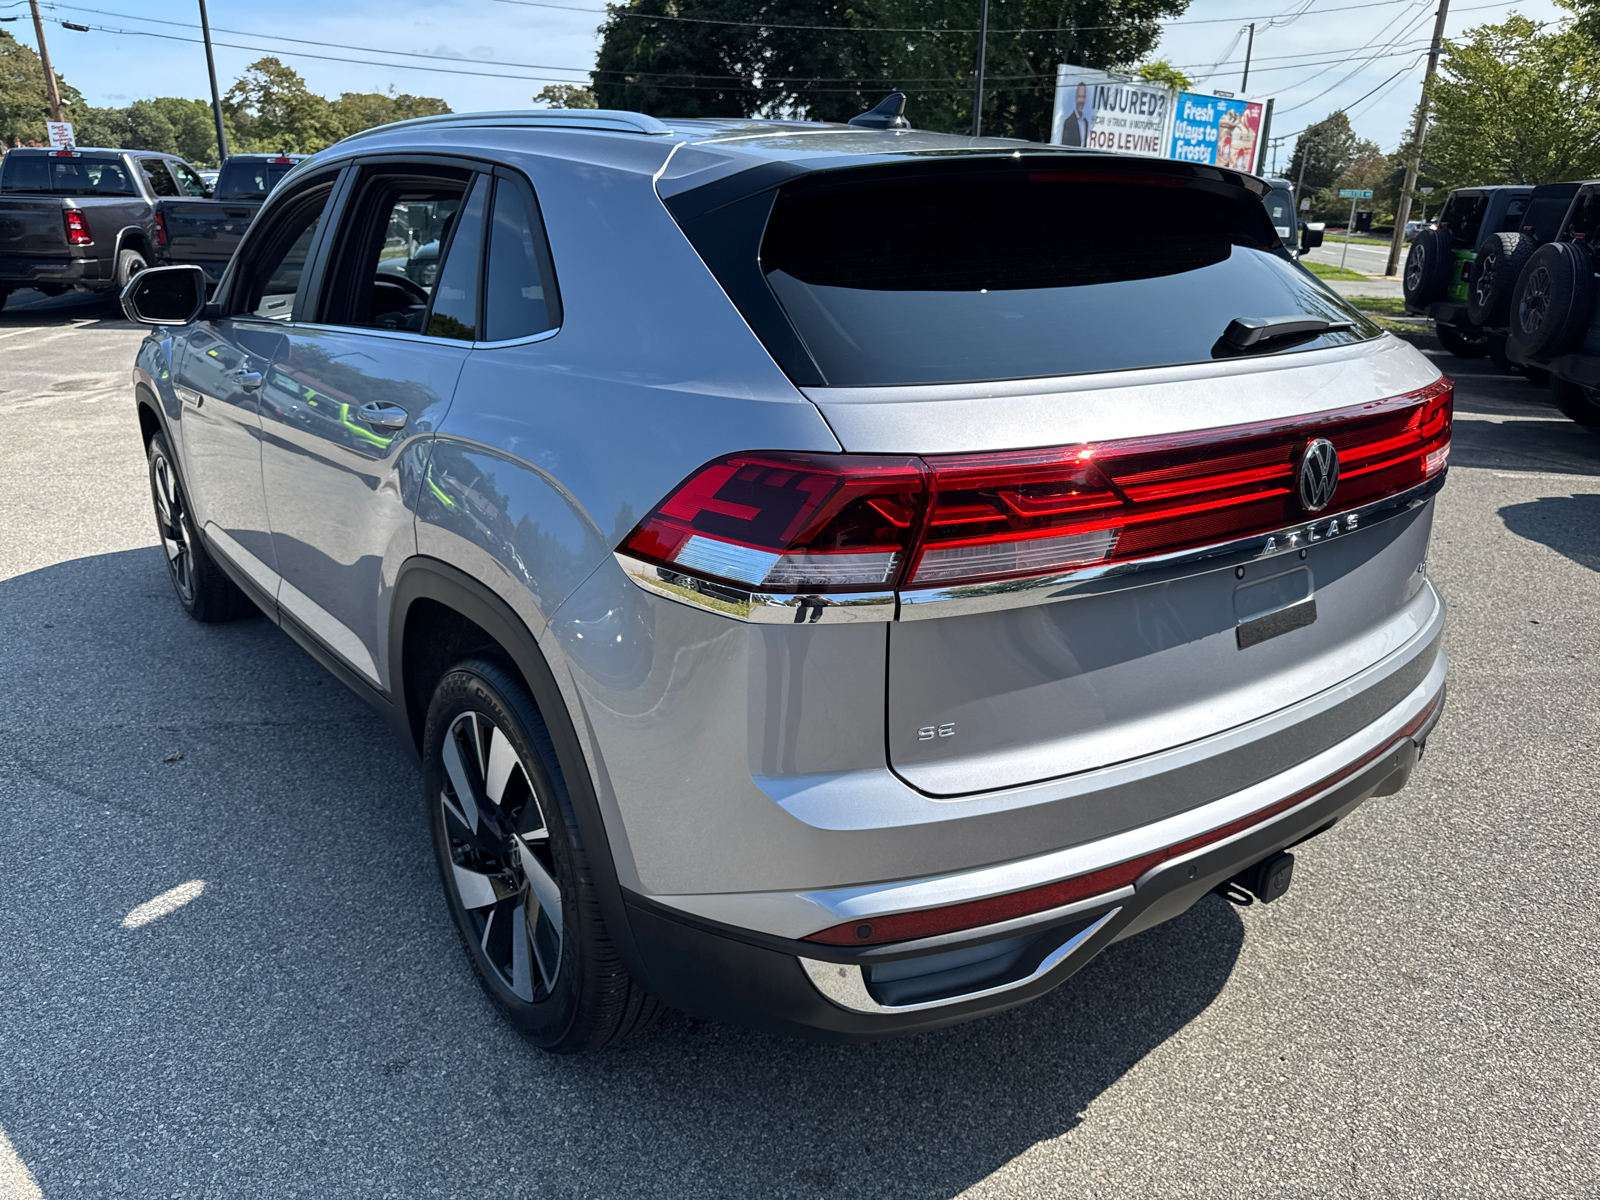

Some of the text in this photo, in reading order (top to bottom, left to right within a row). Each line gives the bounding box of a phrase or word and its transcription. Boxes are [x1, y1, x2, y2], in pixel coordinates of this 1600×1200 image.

[1092, 86, 1166, 117] INJURED?
[1183, 101, 1214, 122] Fresh
[1089, 130, 1159, 152] ROB LEVINE
[1174, 120, 1217, 145] Ways to
[1175, 140, 1212, 164] Frosty
[1261, 513, 1359, 554] ATLAS
[917, 722, 955, 741] SE
